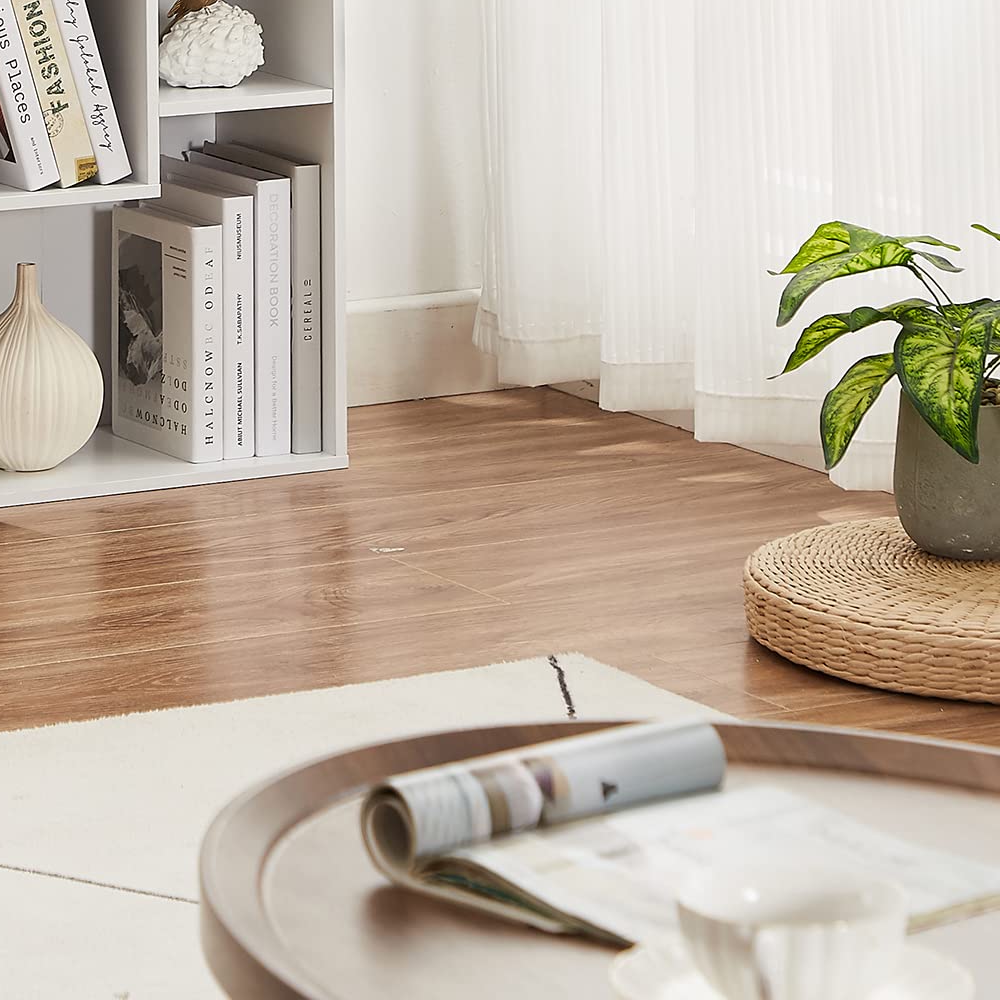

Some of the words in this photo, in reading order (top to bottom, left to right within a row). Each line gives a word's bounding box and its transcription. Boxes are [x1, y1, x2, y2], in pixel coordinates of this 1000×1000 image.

[23, 0, 70, 115] FASHION
[4, 58, 32, 125] Places
[269, 193, 279, 284] DECORATION
[269, 287, 279, 328] BOOK
[303, 291, 313, 342] CEREAL
